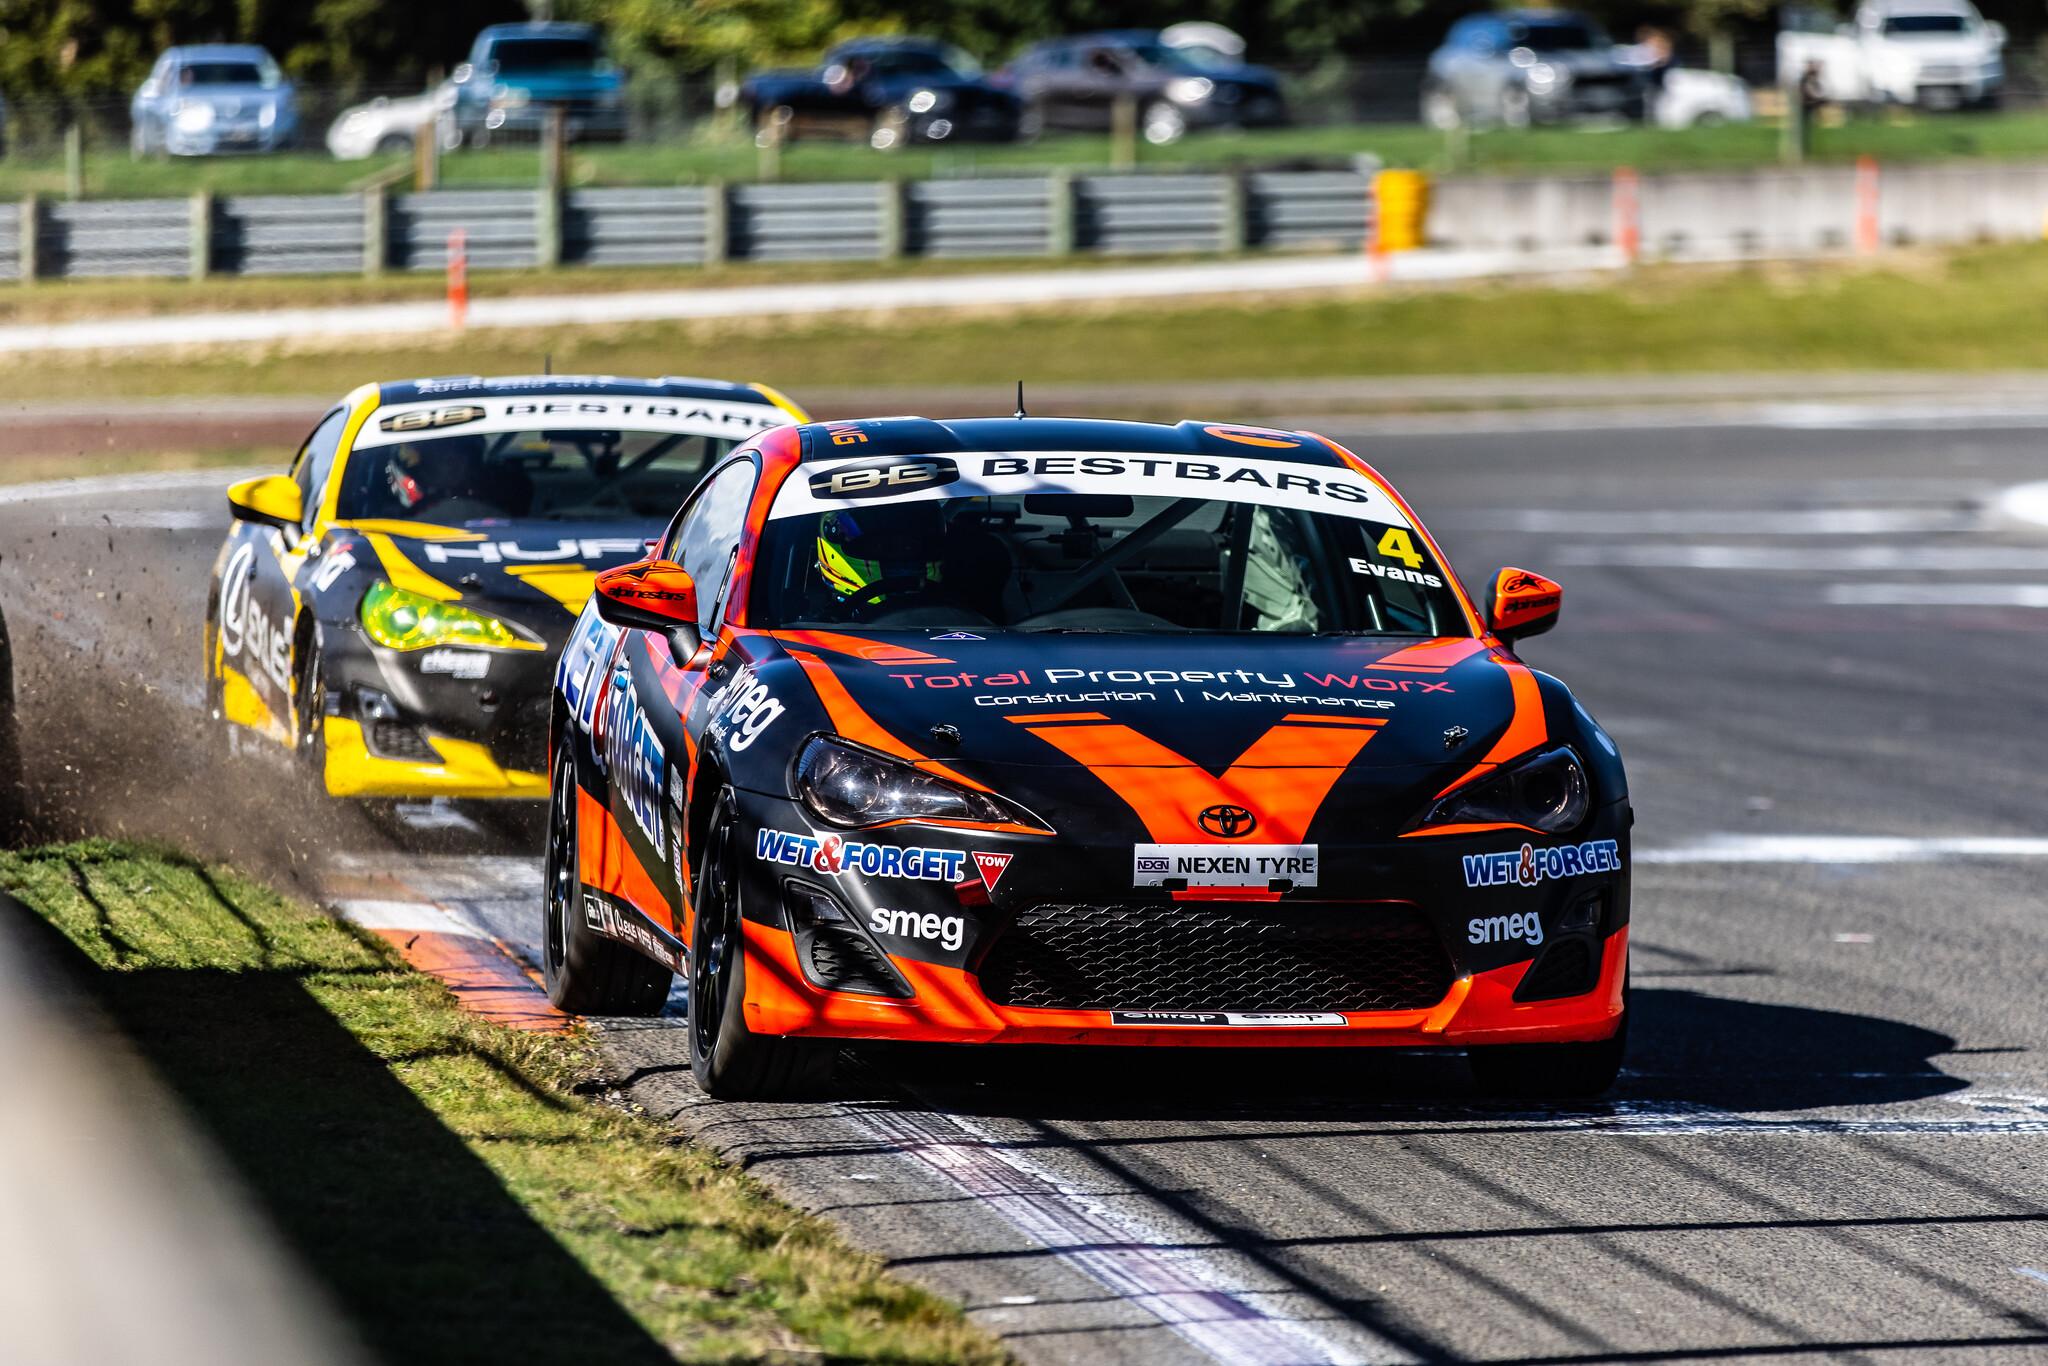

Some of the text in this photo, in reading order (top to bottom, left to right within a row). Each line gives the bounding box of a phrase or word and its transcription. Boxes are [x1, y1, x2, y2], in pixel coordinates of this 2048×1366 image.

[982, 457, 1369, 503] BESTBARS
[1377, 527, 1424, 569] 4
[1348, 557, 1442, 588] Evans
[888, 669, 1456, 693] Total Property Worx
[974, 691, 1156, 706] Construction
[1202, 690, 1396, 710] Maintenance
[977, 855, 1007, 867] TOW
[1177, 857, 1314, 873] NEXEN TYRE
[868, 906, 964, 950] smeg
[1468, 912, 1544, 945] smeg
